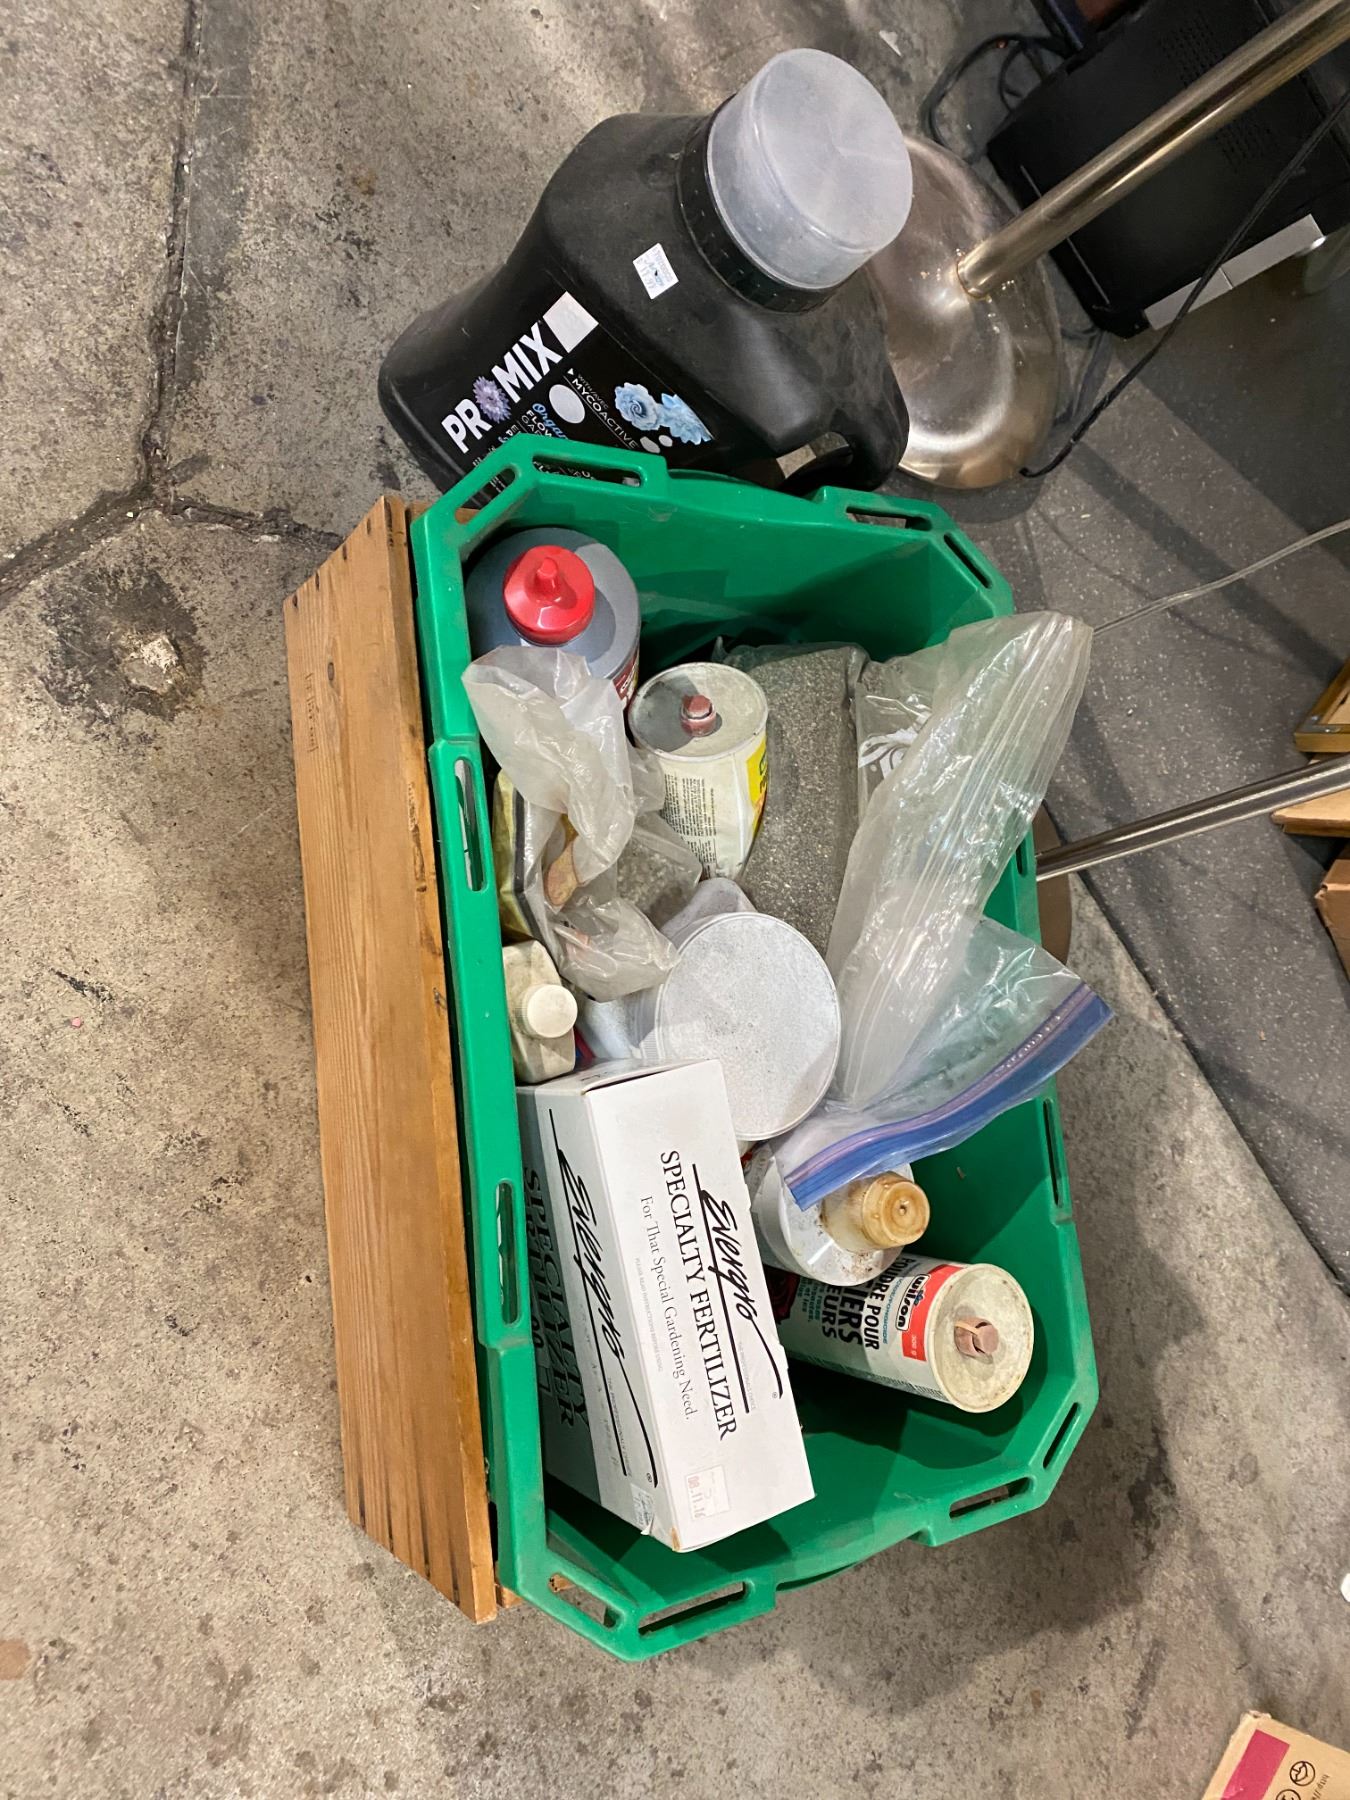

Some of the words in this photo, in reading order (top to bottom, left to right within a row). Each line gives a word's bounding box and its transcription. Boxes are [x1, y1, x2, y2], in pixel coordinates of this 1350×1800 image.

[572, 378, 640, 449] MYCOACTIVE
[641, 1195, 654, 1219] For
[646, 1221, 661, 1254] That
[524, 1166, 591, 1433] SPECIALTY
[650, 1256, 675, 1303] Special
[660, 1150, 706, 1283] SPECIALTY
[690, 1288, 738, 1441] FERTILIZER
[868, 1258, 916, 1301] POUDRE
[898, 1276, 926, 1328] wilson
[525, 1218, 575, 1427] RTILIZER
[822, 1285, 842, 1339] EURS
[838, 1283, 872, 1346] IERS
[864, 1304, 881, 1350] POUR
[664, 1306, 685, 1379] Gardening
[680, 1380, 698, 1420] Need.
